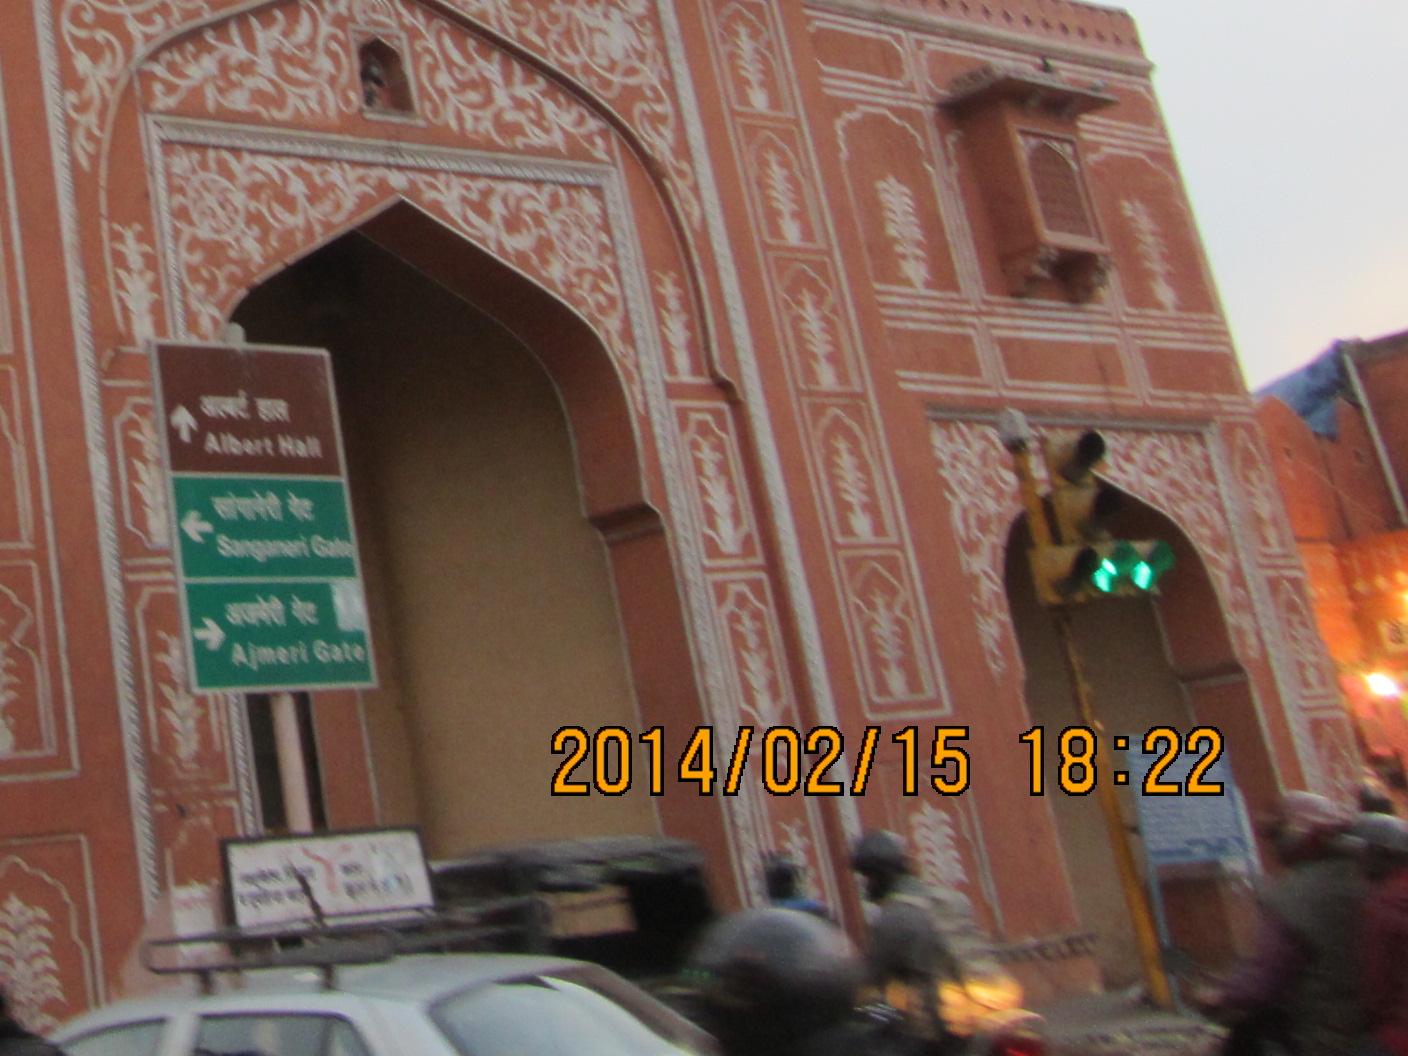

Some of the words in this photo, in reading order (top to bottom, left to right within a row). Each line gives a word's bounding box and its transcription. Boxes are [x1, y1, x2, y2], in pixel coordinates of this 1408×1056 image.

[203, 431, 274, 457] Albert
[277, 433, 324, 459] Hall
[287, 490, 316, 522] गेट
[216, 534, 311, 562] Sanganeri
[312, 535, 356, 559] Gate
[291, 594, 319, 625] गेट
[231, 639, 309, 671] Ajmeri
[313, 639, 366, 664] Gate
